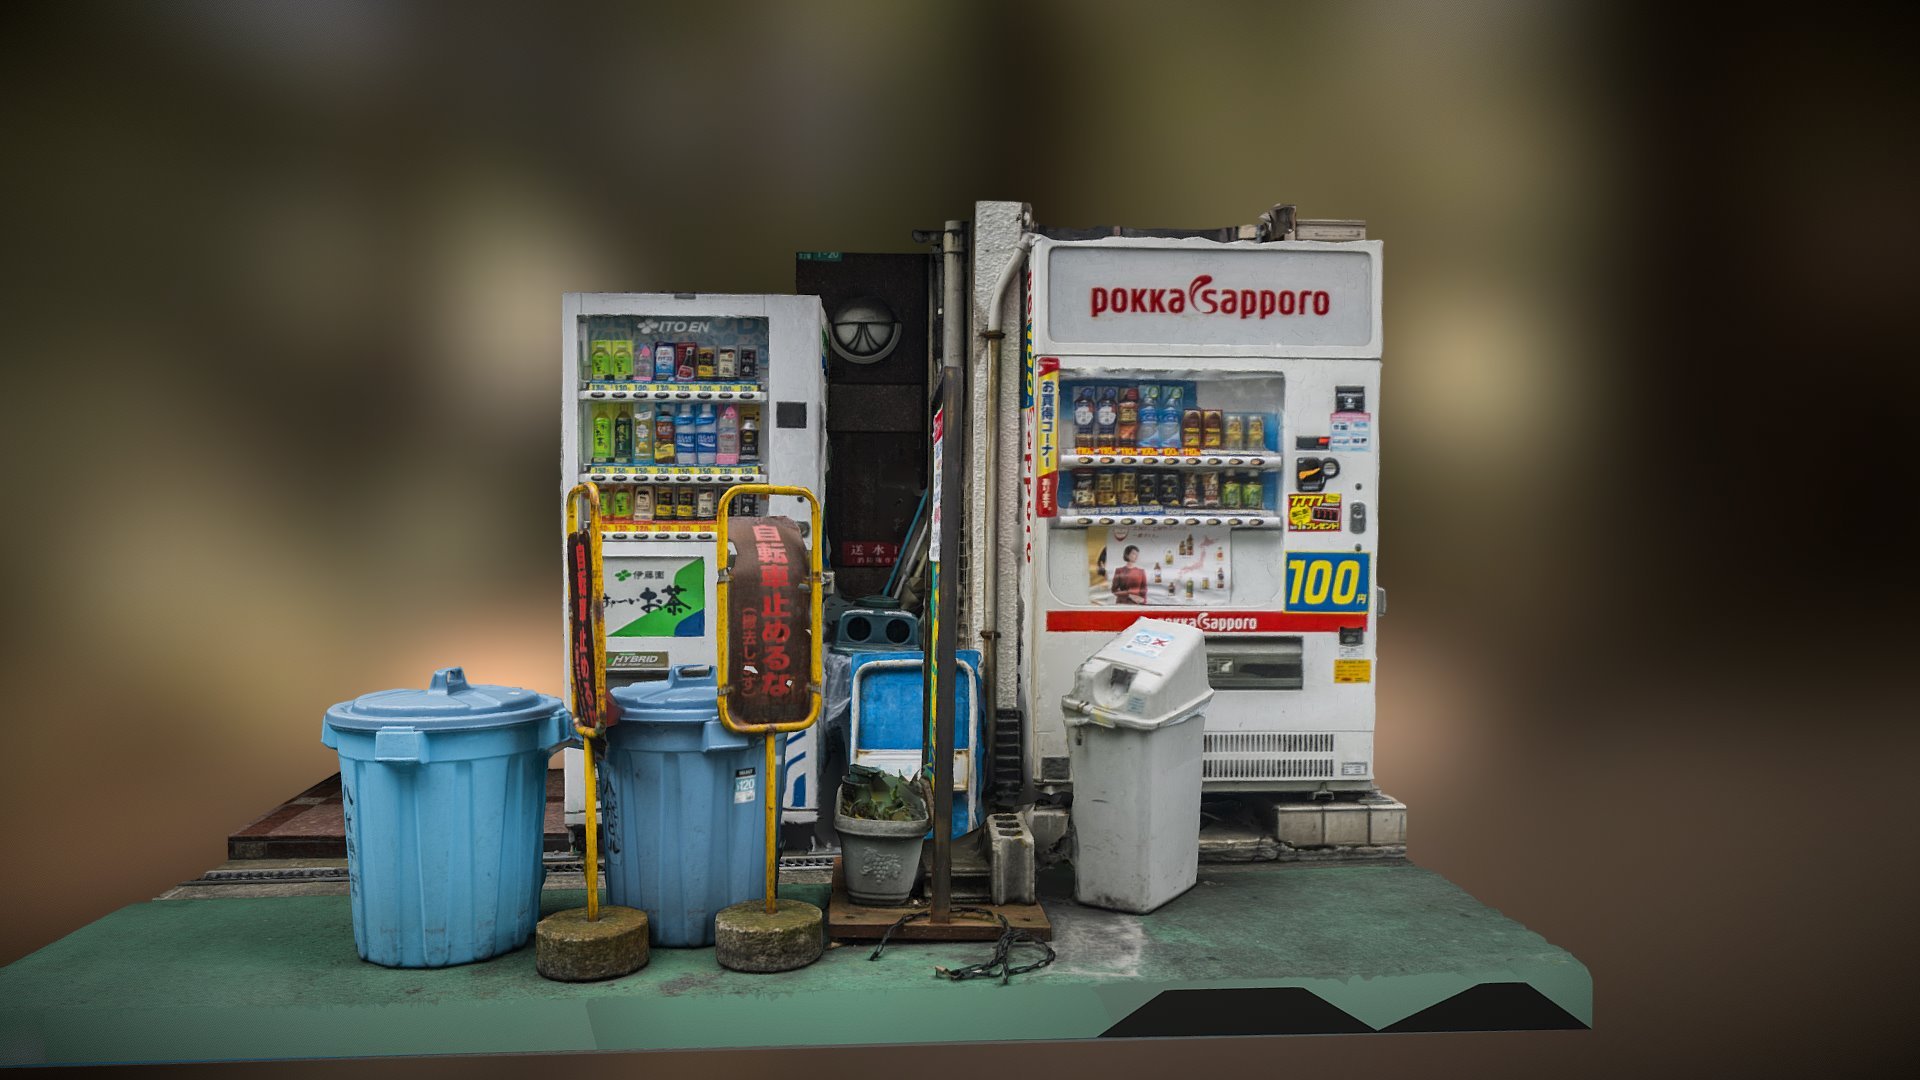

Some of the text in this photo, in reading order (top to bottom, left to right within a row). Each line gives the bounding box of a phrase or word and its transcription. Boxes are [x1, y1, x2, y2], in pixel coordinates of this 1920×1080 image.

[1090, 275, 1330, 320] pokka sapporo
[659, 322, 710, 333] ITO EN
[633, 570, 665, 580] 伊藤園
[752, 524, 791, 697] 自転車止めるな
[611, 655, 659, 667] HYBRID
